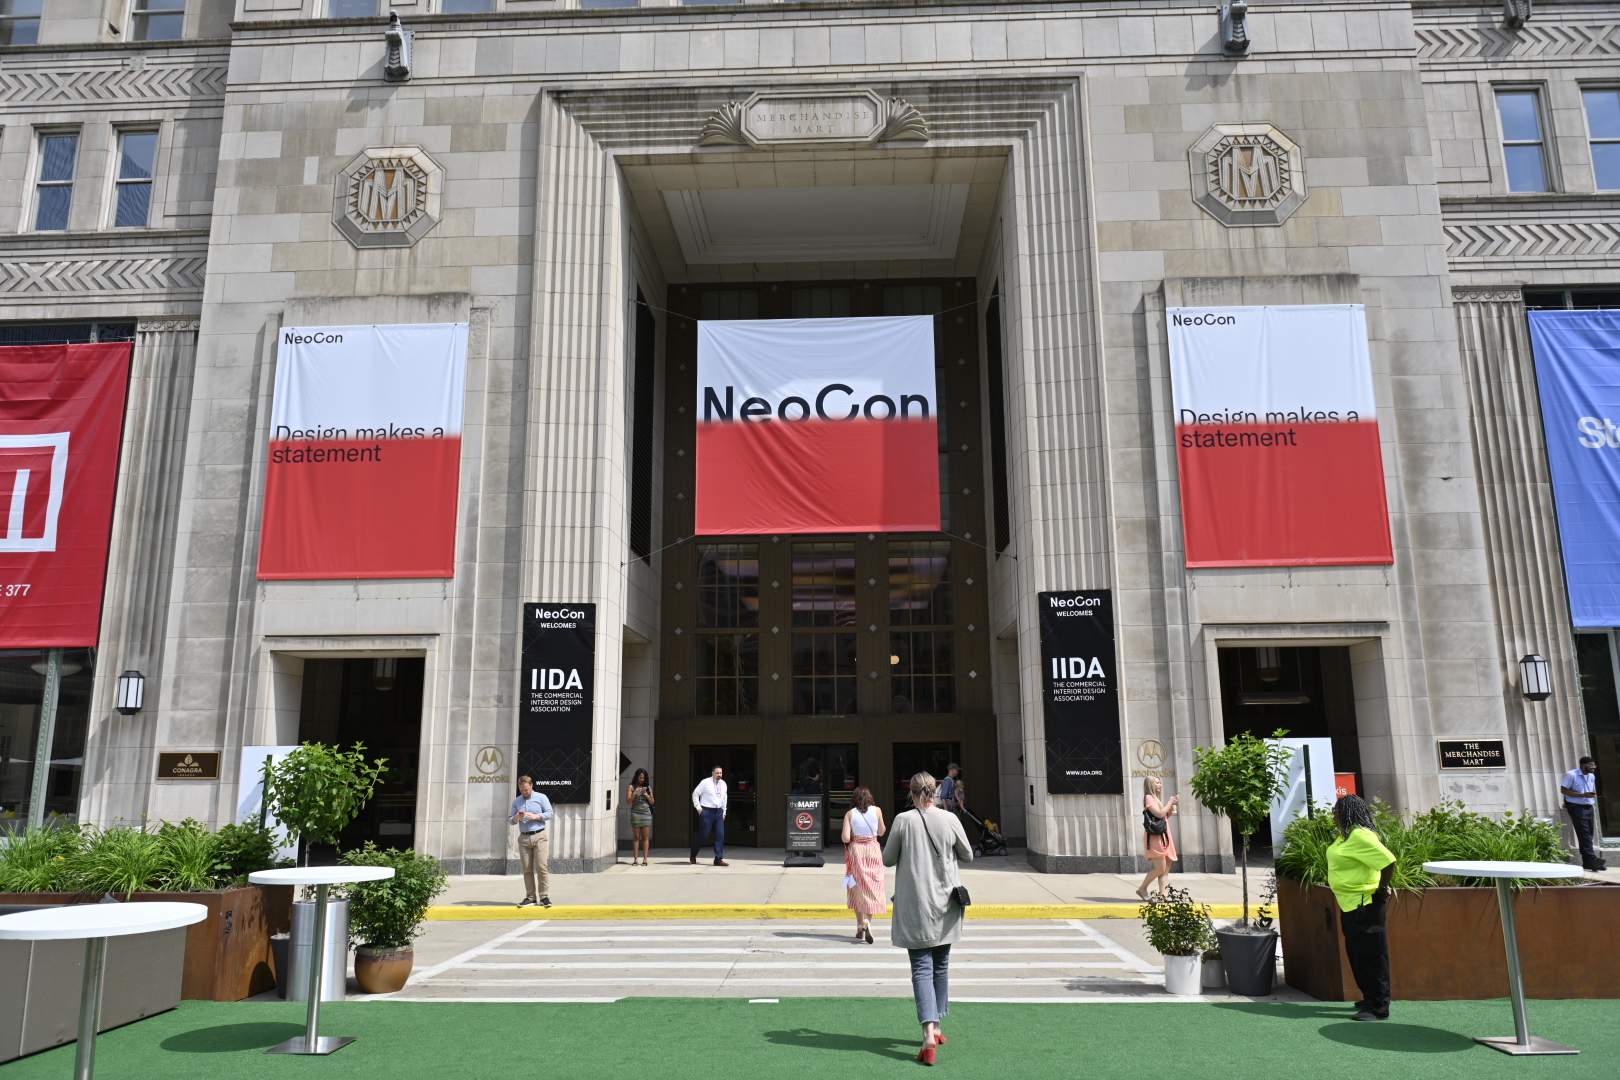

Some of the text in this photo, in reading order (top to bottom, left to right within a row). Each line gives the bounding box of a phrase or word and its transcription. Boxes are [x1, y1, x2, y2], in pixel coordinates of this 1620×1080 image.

[757, 111, 870, 122] MERCHANDISE
[792, 125, 834, 134] MART
[1172, 313, 1236, 327] NeoCon
[284, 332, 344, 345] NeoCon
[703, 383, 930, 425] NeoCon
[1180, 406, 1360, 427] Design makes a
[275, 423, 444, 442] Design makes a
[1181, 428, 1298, 448] statement
[1577, 416, 1620, 449] St
[272, 444, 382, 463] statement
[5, 584, 32, 597] 377
[1050, 596, 1101, 608] NeoCon
[535, 608, 585, 619] NeoCon
[1052, 656, 1106, 679] IIDA
[531, 668, 584, 690] IIDA
[1445, 750, 1501, 758] MERCHANDISE
[1462, 758, 1485, 766] MART
[469, 775, 509, 783] motorola
